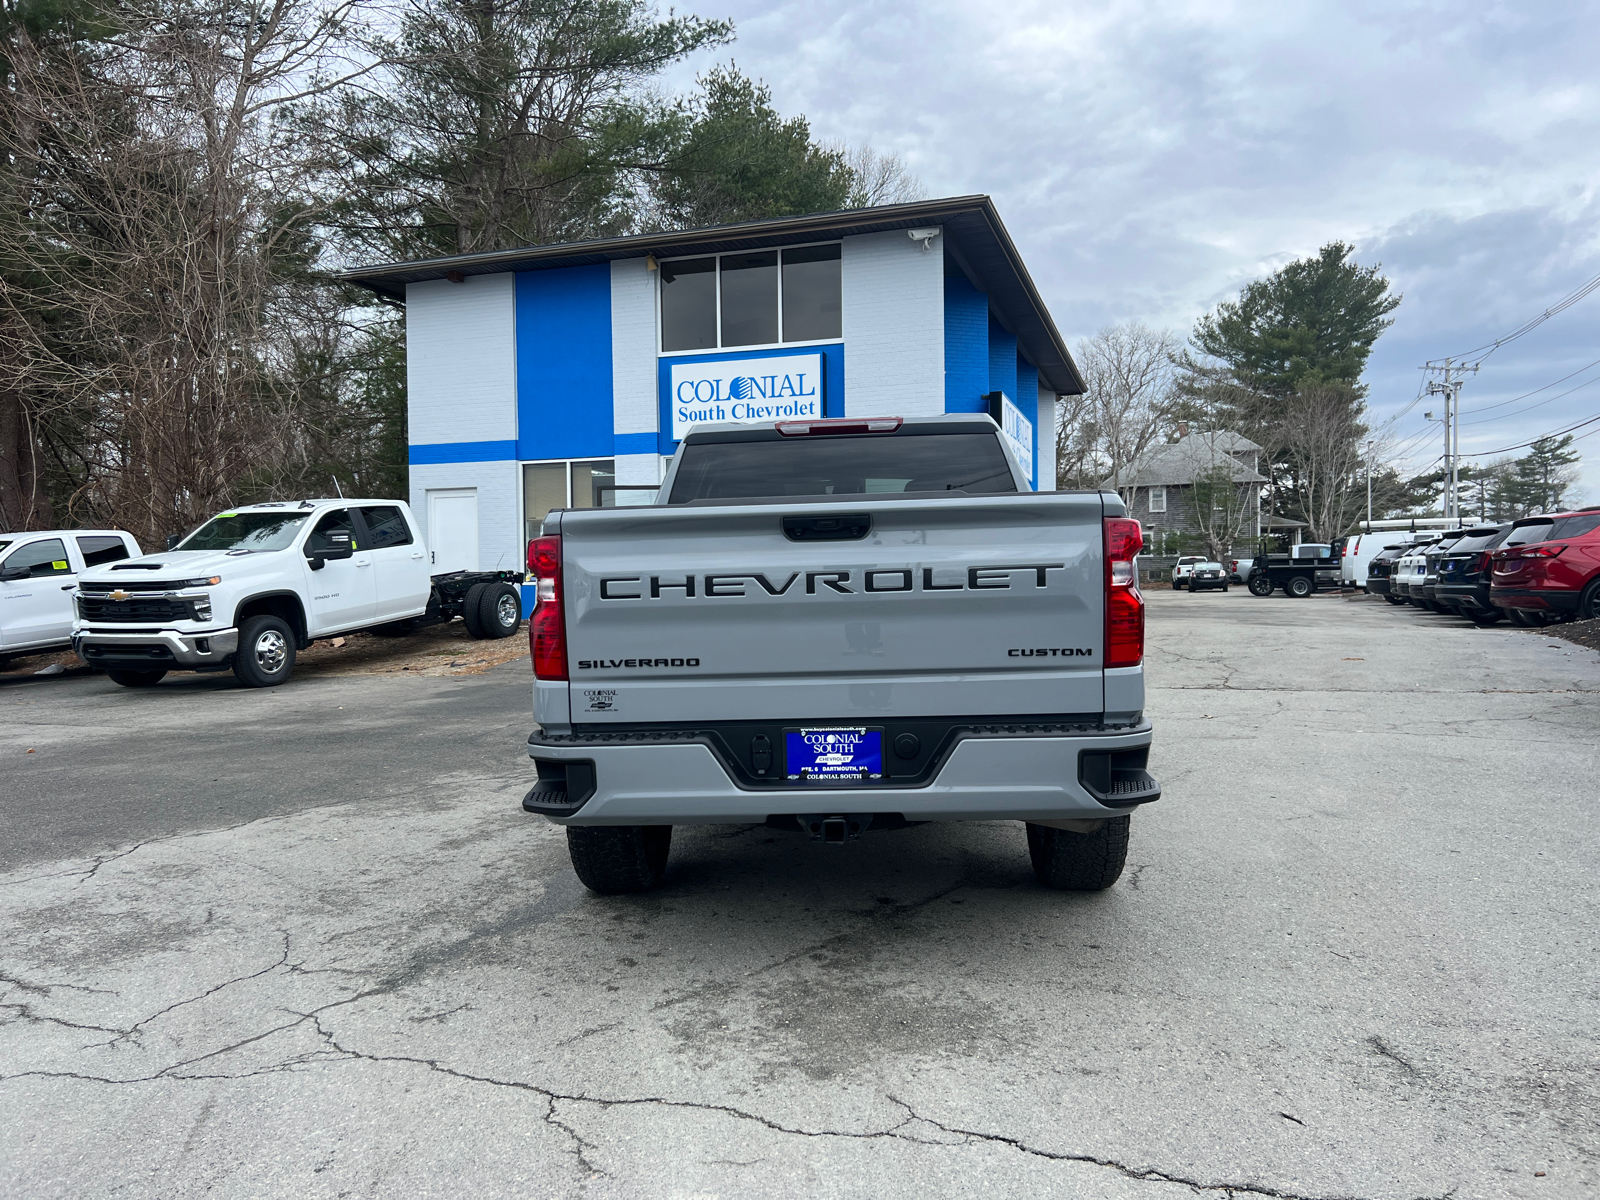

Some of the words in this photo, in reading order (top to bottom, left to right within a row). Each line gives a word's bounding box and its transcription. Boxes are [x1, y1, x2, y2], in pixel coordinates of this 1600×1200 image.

[677, 373, 815, 403] COLONIAL
[678, 404, 725, 422] South
[731, 400, 815, 419] Chevrolet
[600, 563, 1065, 600] CHEVROLET
[1007, 648, 1093, 657] CUSTOM
[578, 658, 700, 669] SILVERADO
[804, 733, 863, 744] COLONIAL
[813, 744, 854, 753] SOUTH
